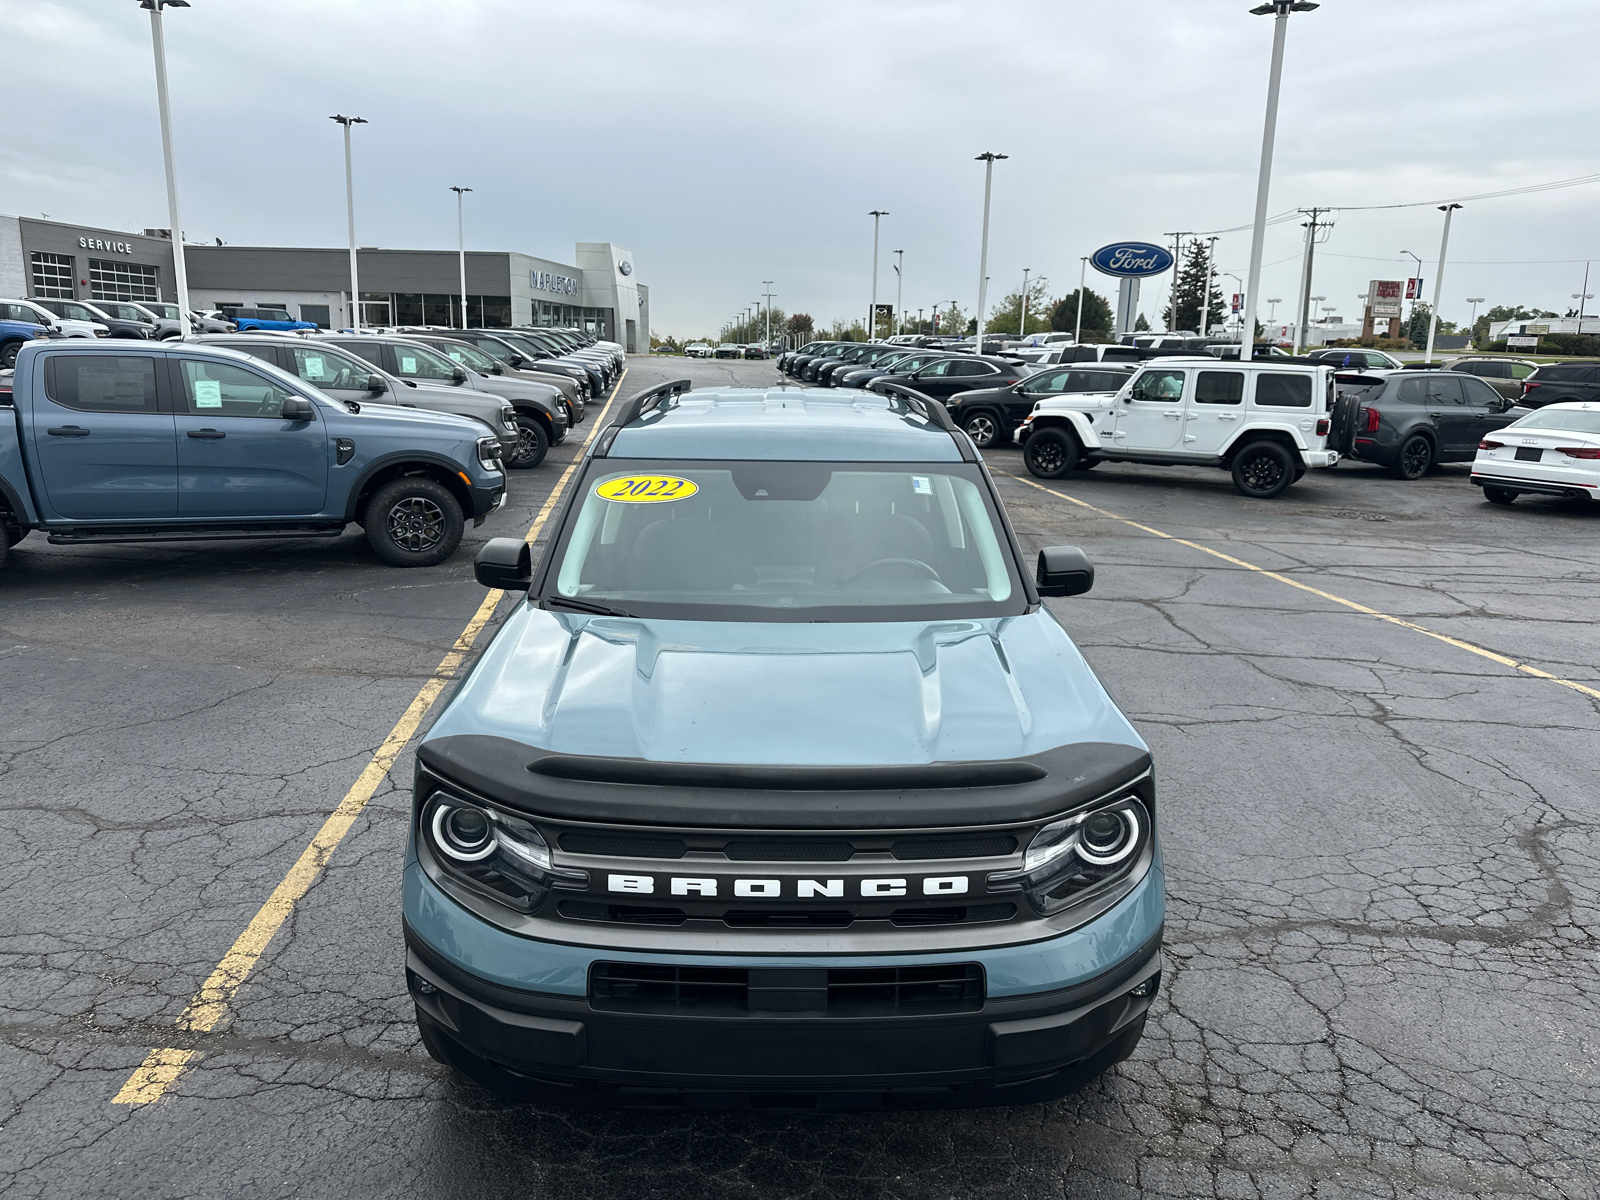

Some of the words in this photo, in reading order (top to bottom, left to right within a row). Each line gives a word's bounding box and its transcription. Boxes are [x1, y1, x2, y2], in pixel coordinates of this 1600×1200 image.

[79, 236, 132, 254] SERVICE
[1109, 247, 1159, 270] Ford
[530, 269, 579, 296] NAPLETON
[611, 480, 684, 496] 2022
[607, 873, 969, 898] BRONCO
